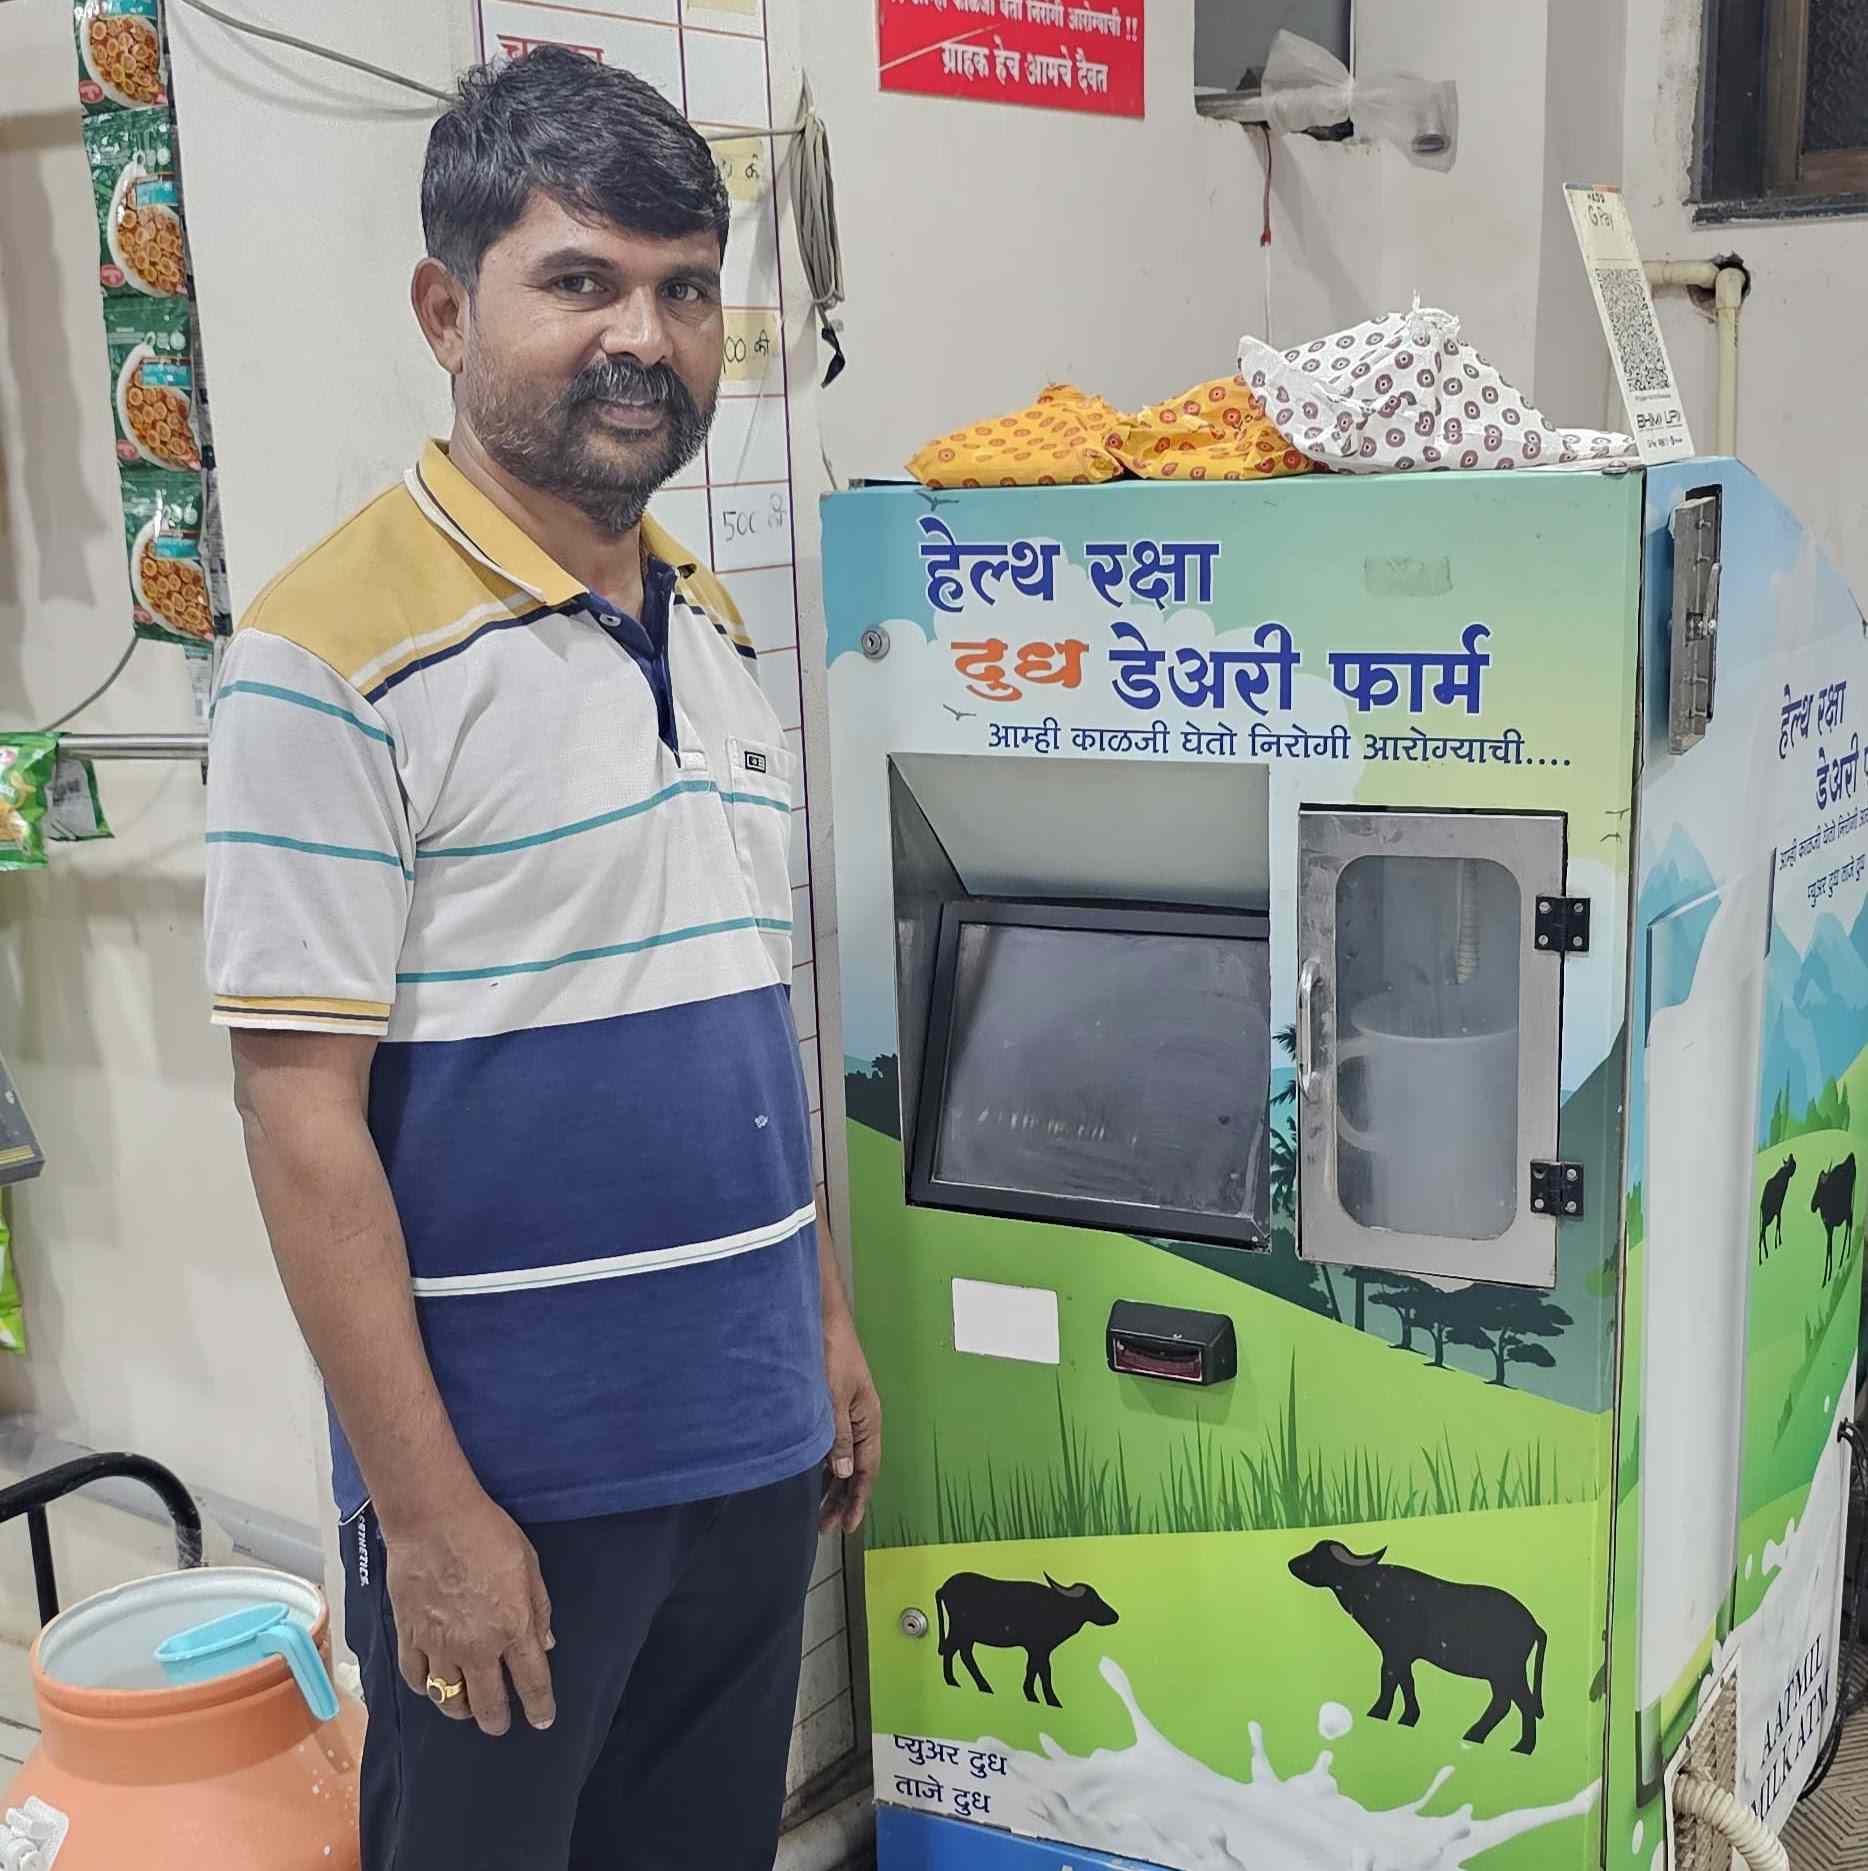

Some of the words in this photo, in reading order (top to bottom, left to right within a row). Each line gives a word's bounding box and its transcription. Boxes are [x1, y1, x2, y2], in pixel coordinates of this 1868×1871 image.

[941, 42, 990, 81] ग्राहक
[994, 35, 1021, 85] हेच
[1025, 46, 1073, 89] आमचे
[1077, 49, 1109, 94] दैवत
[919, 516, 1061, 612] हेल्थ
[1085, 540, 1220, 610] रक्षा
[950, 637, 1090, 702] दुध
[1108, 621, 1301, 716] डेअरी
[1328, 623, 1491, 714] फार्म
[988, 717, 1061, 753] आम्ही
[1071, 720, 1170, 754] काळजी
[1180, 721, 1237, 756] घेतो
[1248, 722, 1352, 760] निरोगी
[1362, 725, 1571, 766] आरोग्याची....
[1779, 683, 1814, 760] हेल्थ
[1817, 680, 1847, 736] रक्षा
[1815, 732, 1859, 811] डेअरी
[893, 1733, 960, 1766] प्युअर
[968, 1749, 1008, 1779] दुध
[893, 1773, 944, 1803] ताजे
[952, 1787, 991, 1817] दुध
